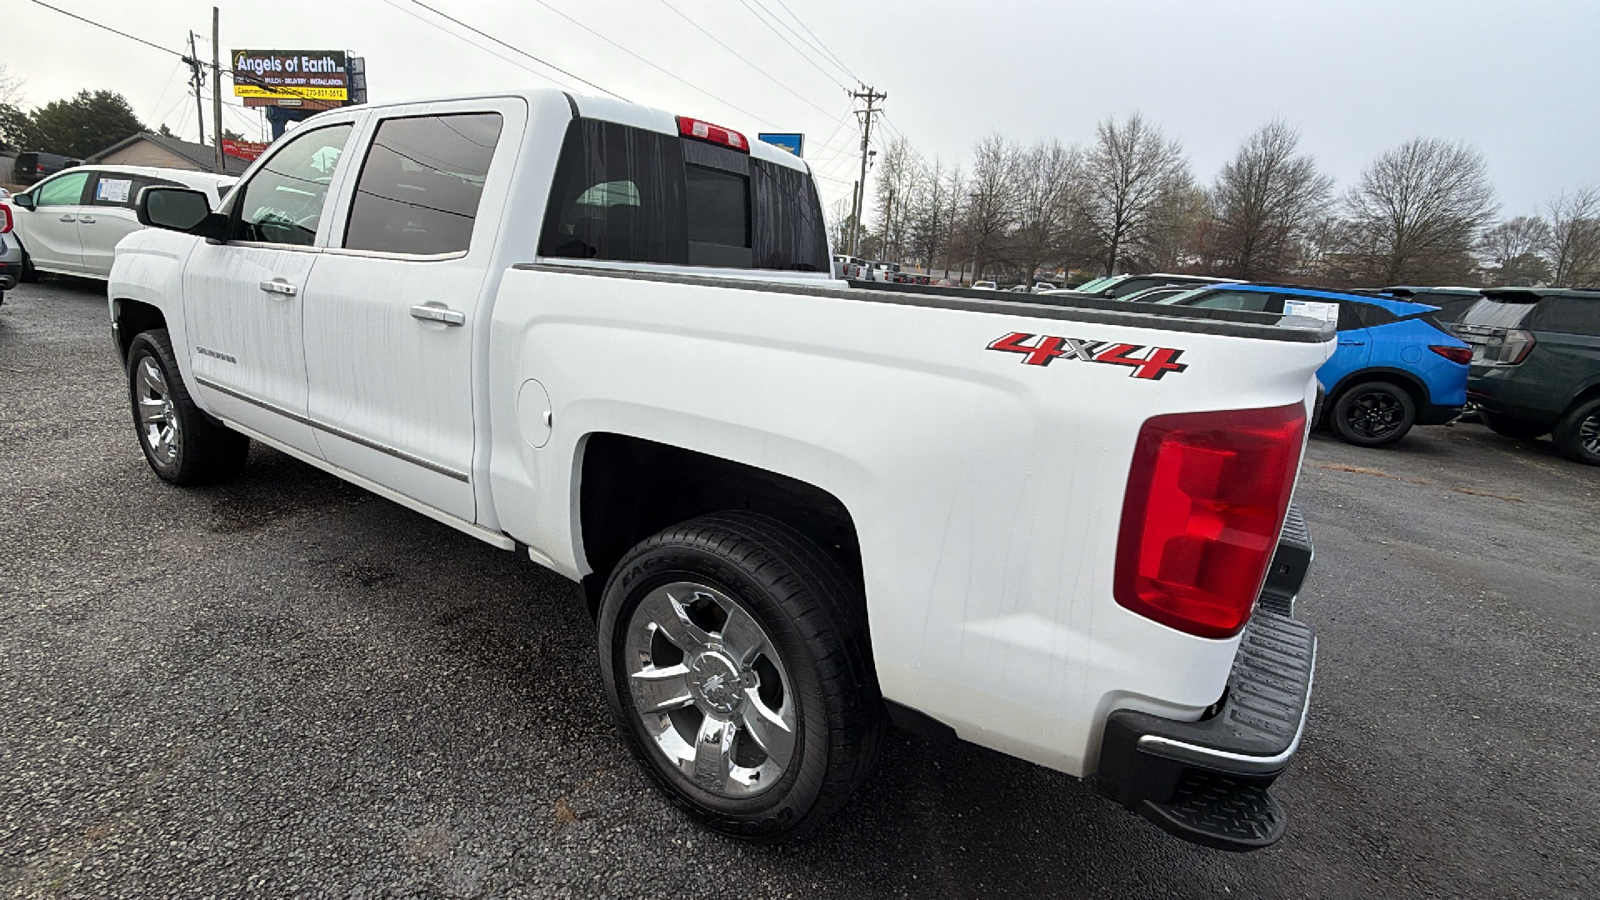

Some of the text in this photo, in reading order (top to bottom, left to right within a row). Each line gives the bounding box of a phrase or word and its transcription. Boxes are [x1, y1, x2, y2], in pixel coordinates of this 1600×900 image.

[238, 55, 282, 75] Angels
[285, 56, 298, 72] of
[301, 57, 336, 73] Earth
[310, 78, 344, 86] INSTALLATION
